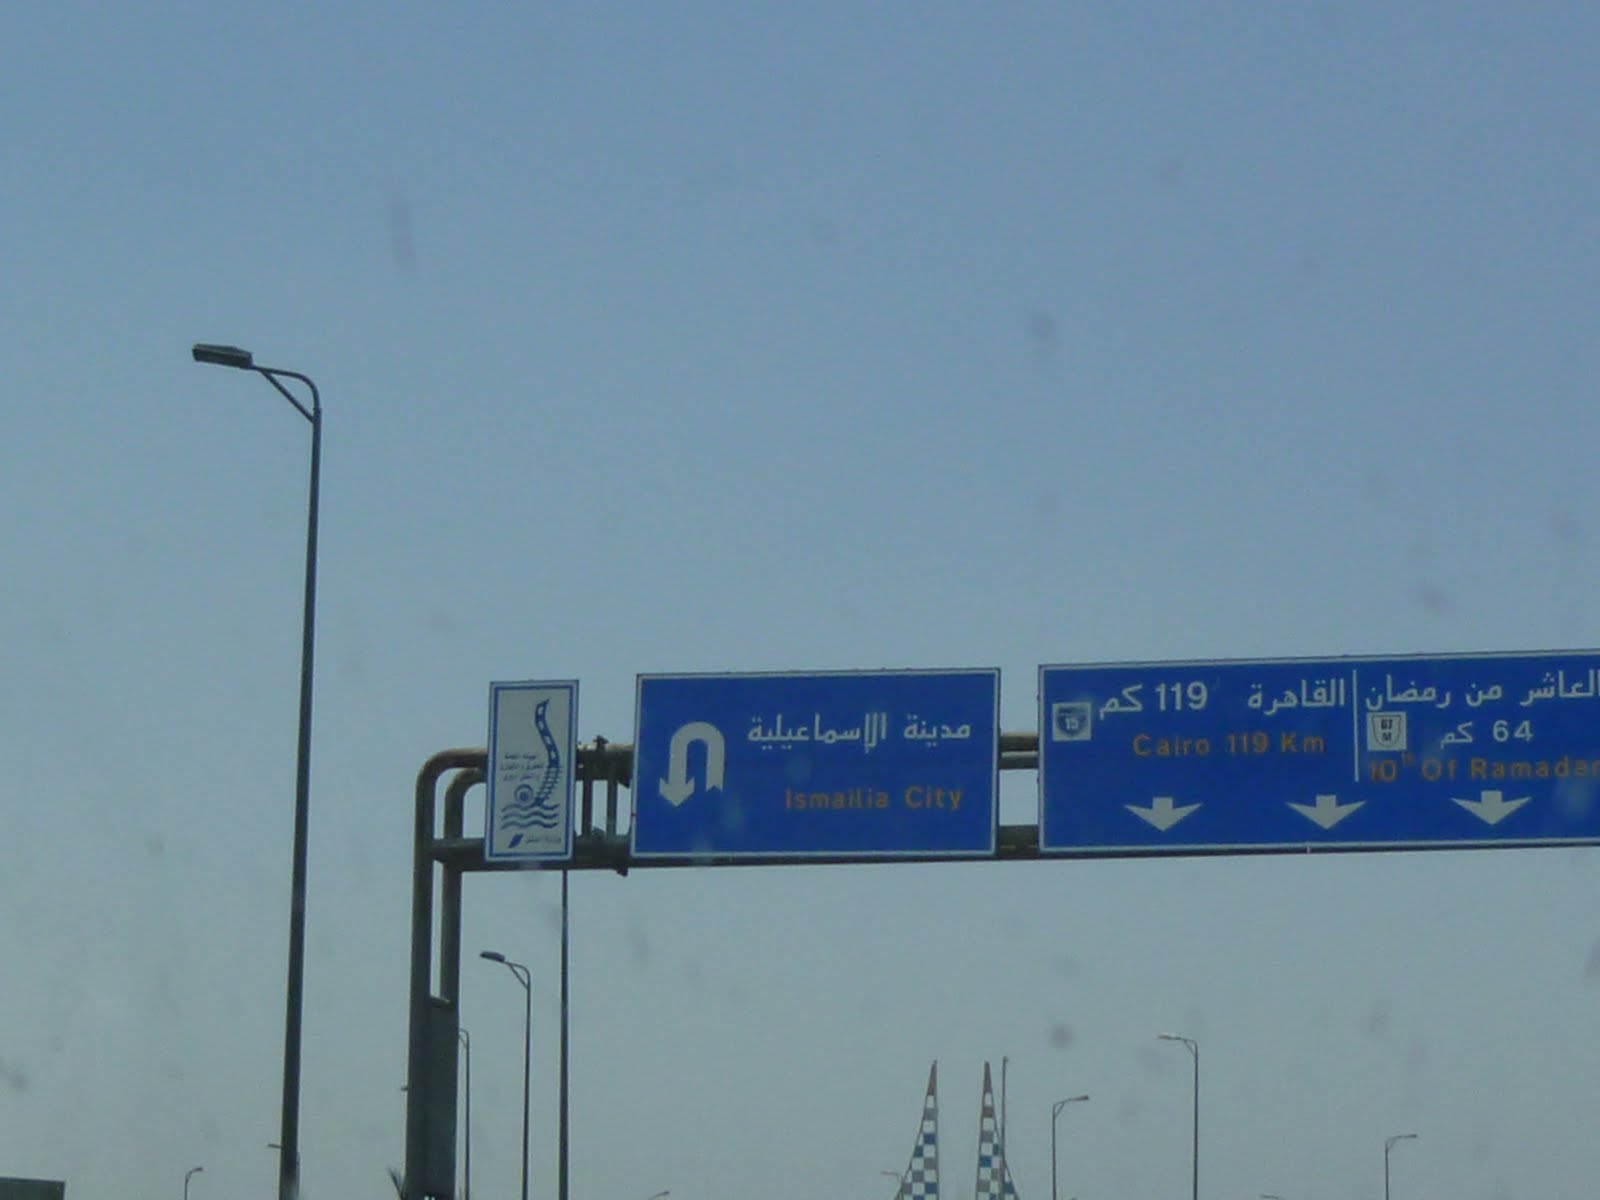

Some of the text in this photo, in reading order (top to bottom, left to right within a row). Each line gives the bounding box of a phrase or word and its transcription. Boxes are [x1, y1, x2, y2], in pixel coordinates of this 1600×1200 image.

[1099, 677, 1346, 720] القاهرة 119 كم
[1366, 674, 1451, 711] رمضان
[1465, 682, 1502, 708] من
[747, 713, 971, 754] مدينة الإسماعيلية
[1132, 731, 1325, 757] Cairo 119 Km
[1440, 719, 1534, 749] 64 كم
[1421, 757, 1457, 782] Of
[785, 785, 962, 811] Ismailia City
